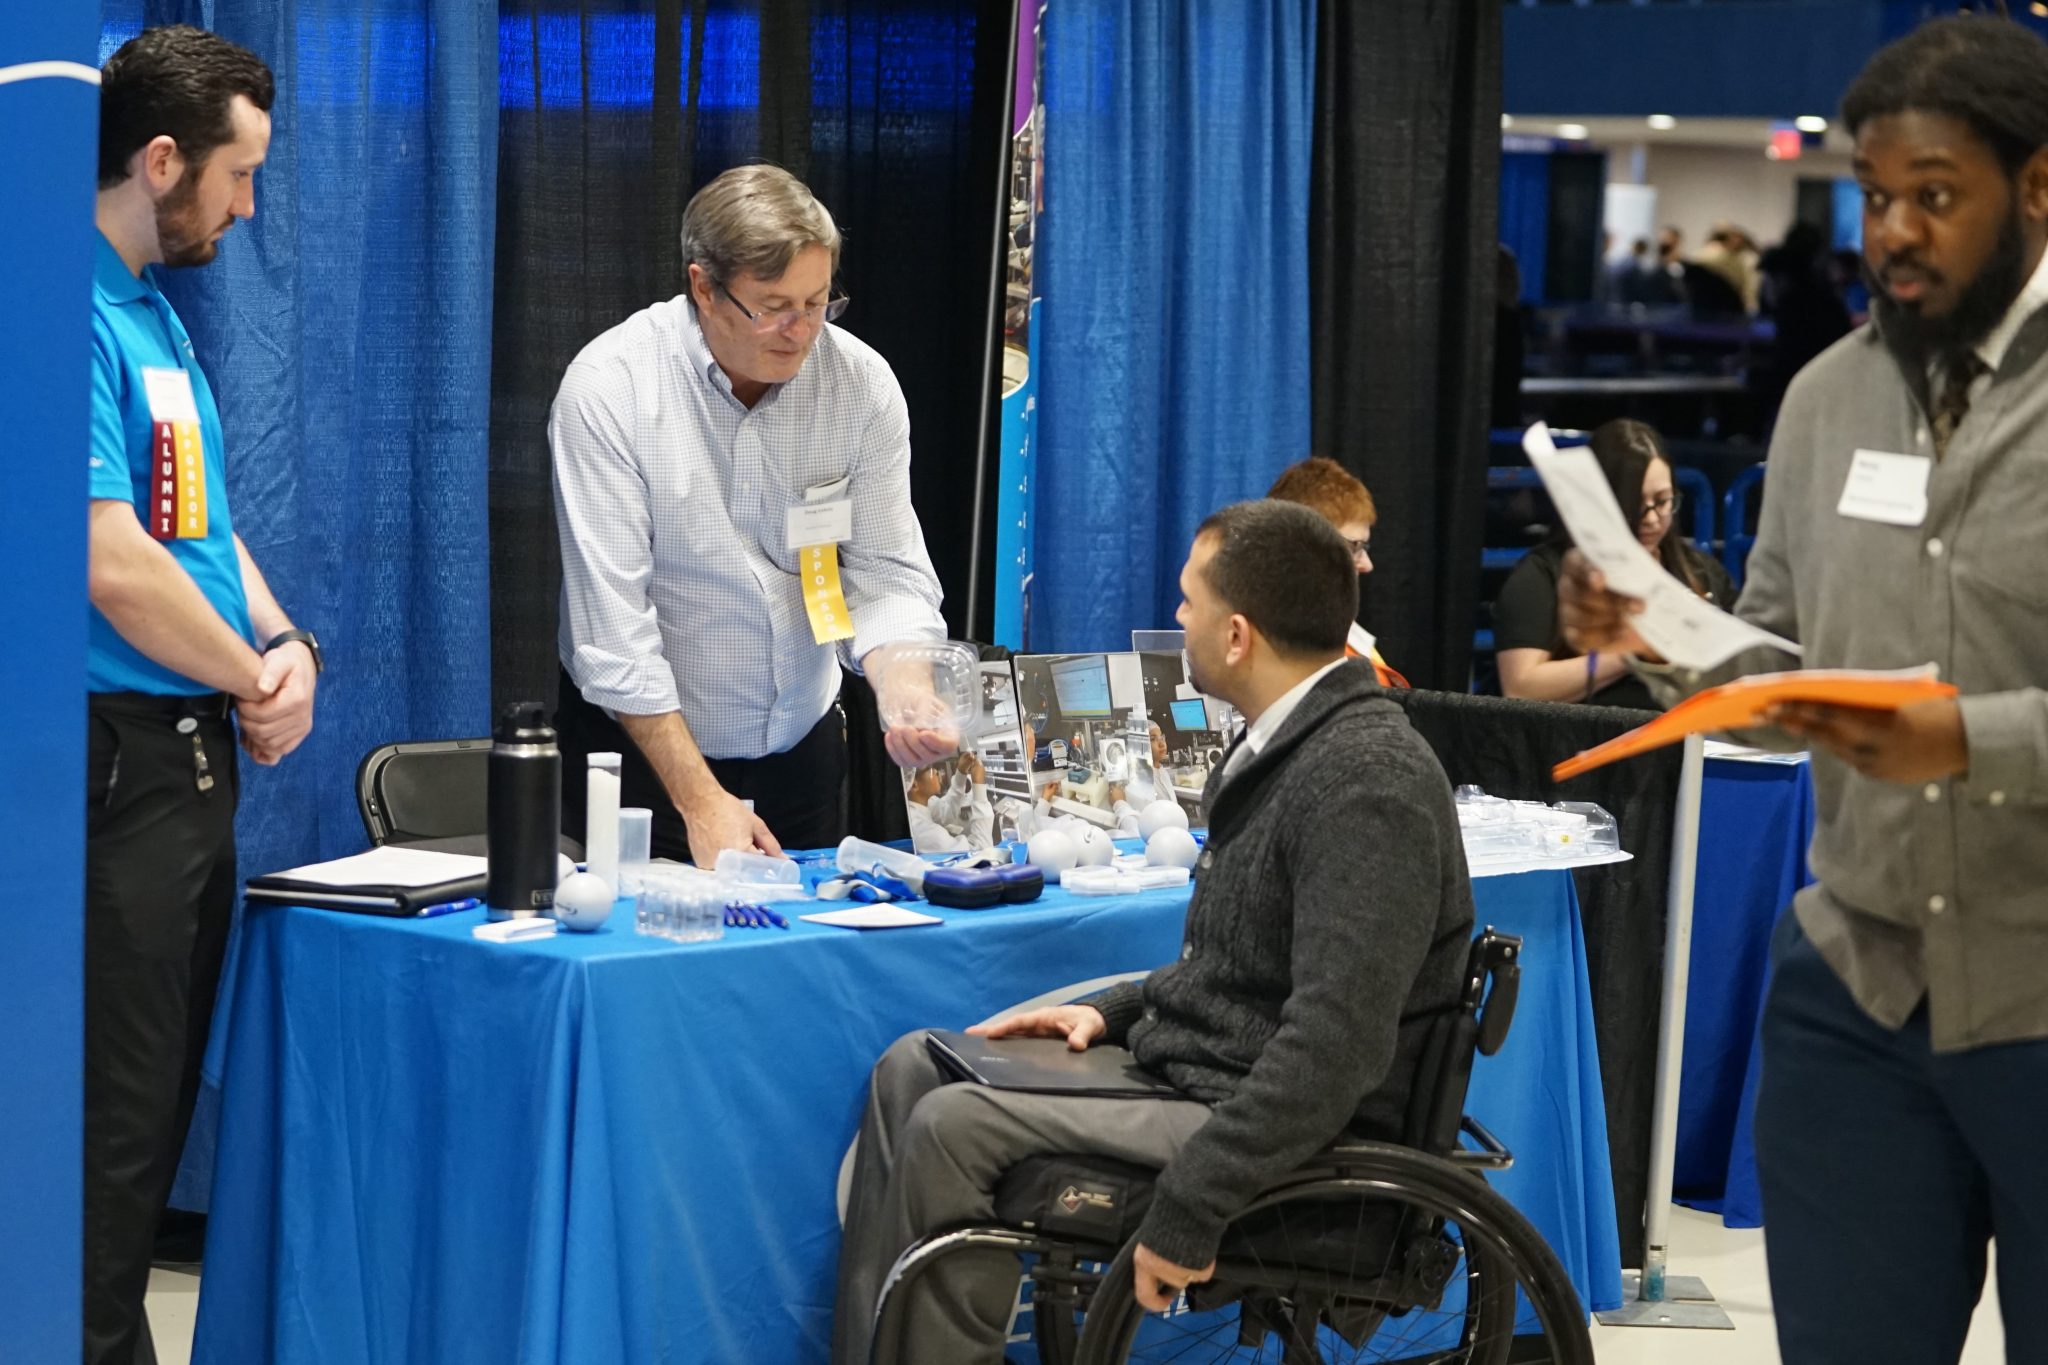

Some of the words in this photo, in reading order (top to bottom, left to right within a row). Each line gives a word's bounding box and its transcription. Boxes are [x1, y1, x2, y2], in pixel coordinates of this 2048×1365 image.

[161, 424, 173, 533] ALUMNI
[181, 423, 198, 529] SPONSOR
[812, 547, 837, 634] SPONSOR
